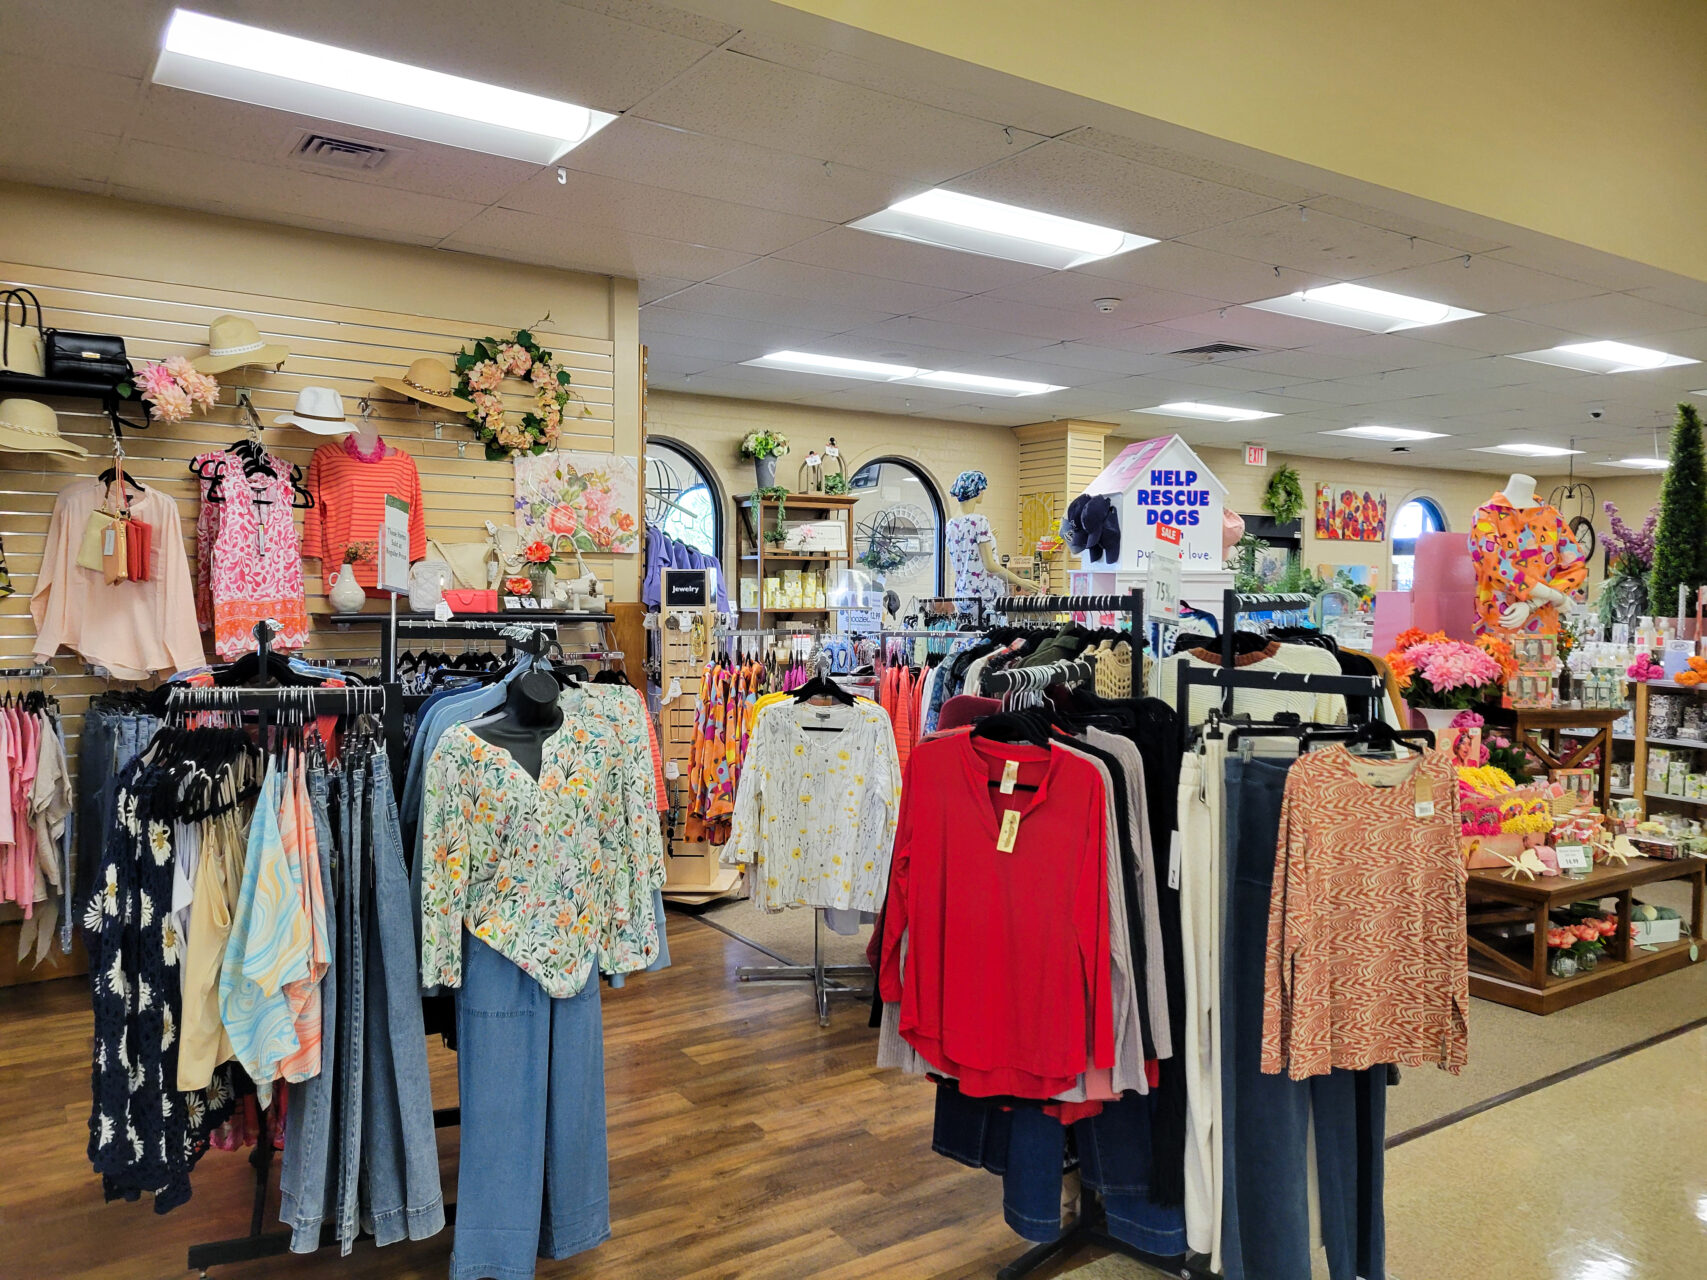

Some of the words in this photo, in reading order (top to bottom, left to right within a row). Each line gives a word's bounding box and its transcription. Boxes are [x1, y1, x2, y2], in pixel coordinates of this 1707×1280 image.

[1248, 446, 1264, 464] EXIT
[1150, 469, 1198, 486] HELP
[1136, 489, 1210, 506] RESCUE
[1146, 509, 1200, 526] DOGS
[1160, 526, 1177, 541] SALE
[391, 538, 399, 548] Sold
[386, 547, 399, 559] Regular
[399, 552, 407, 561] Price
[671, 585, 700, 594] Jewelry
